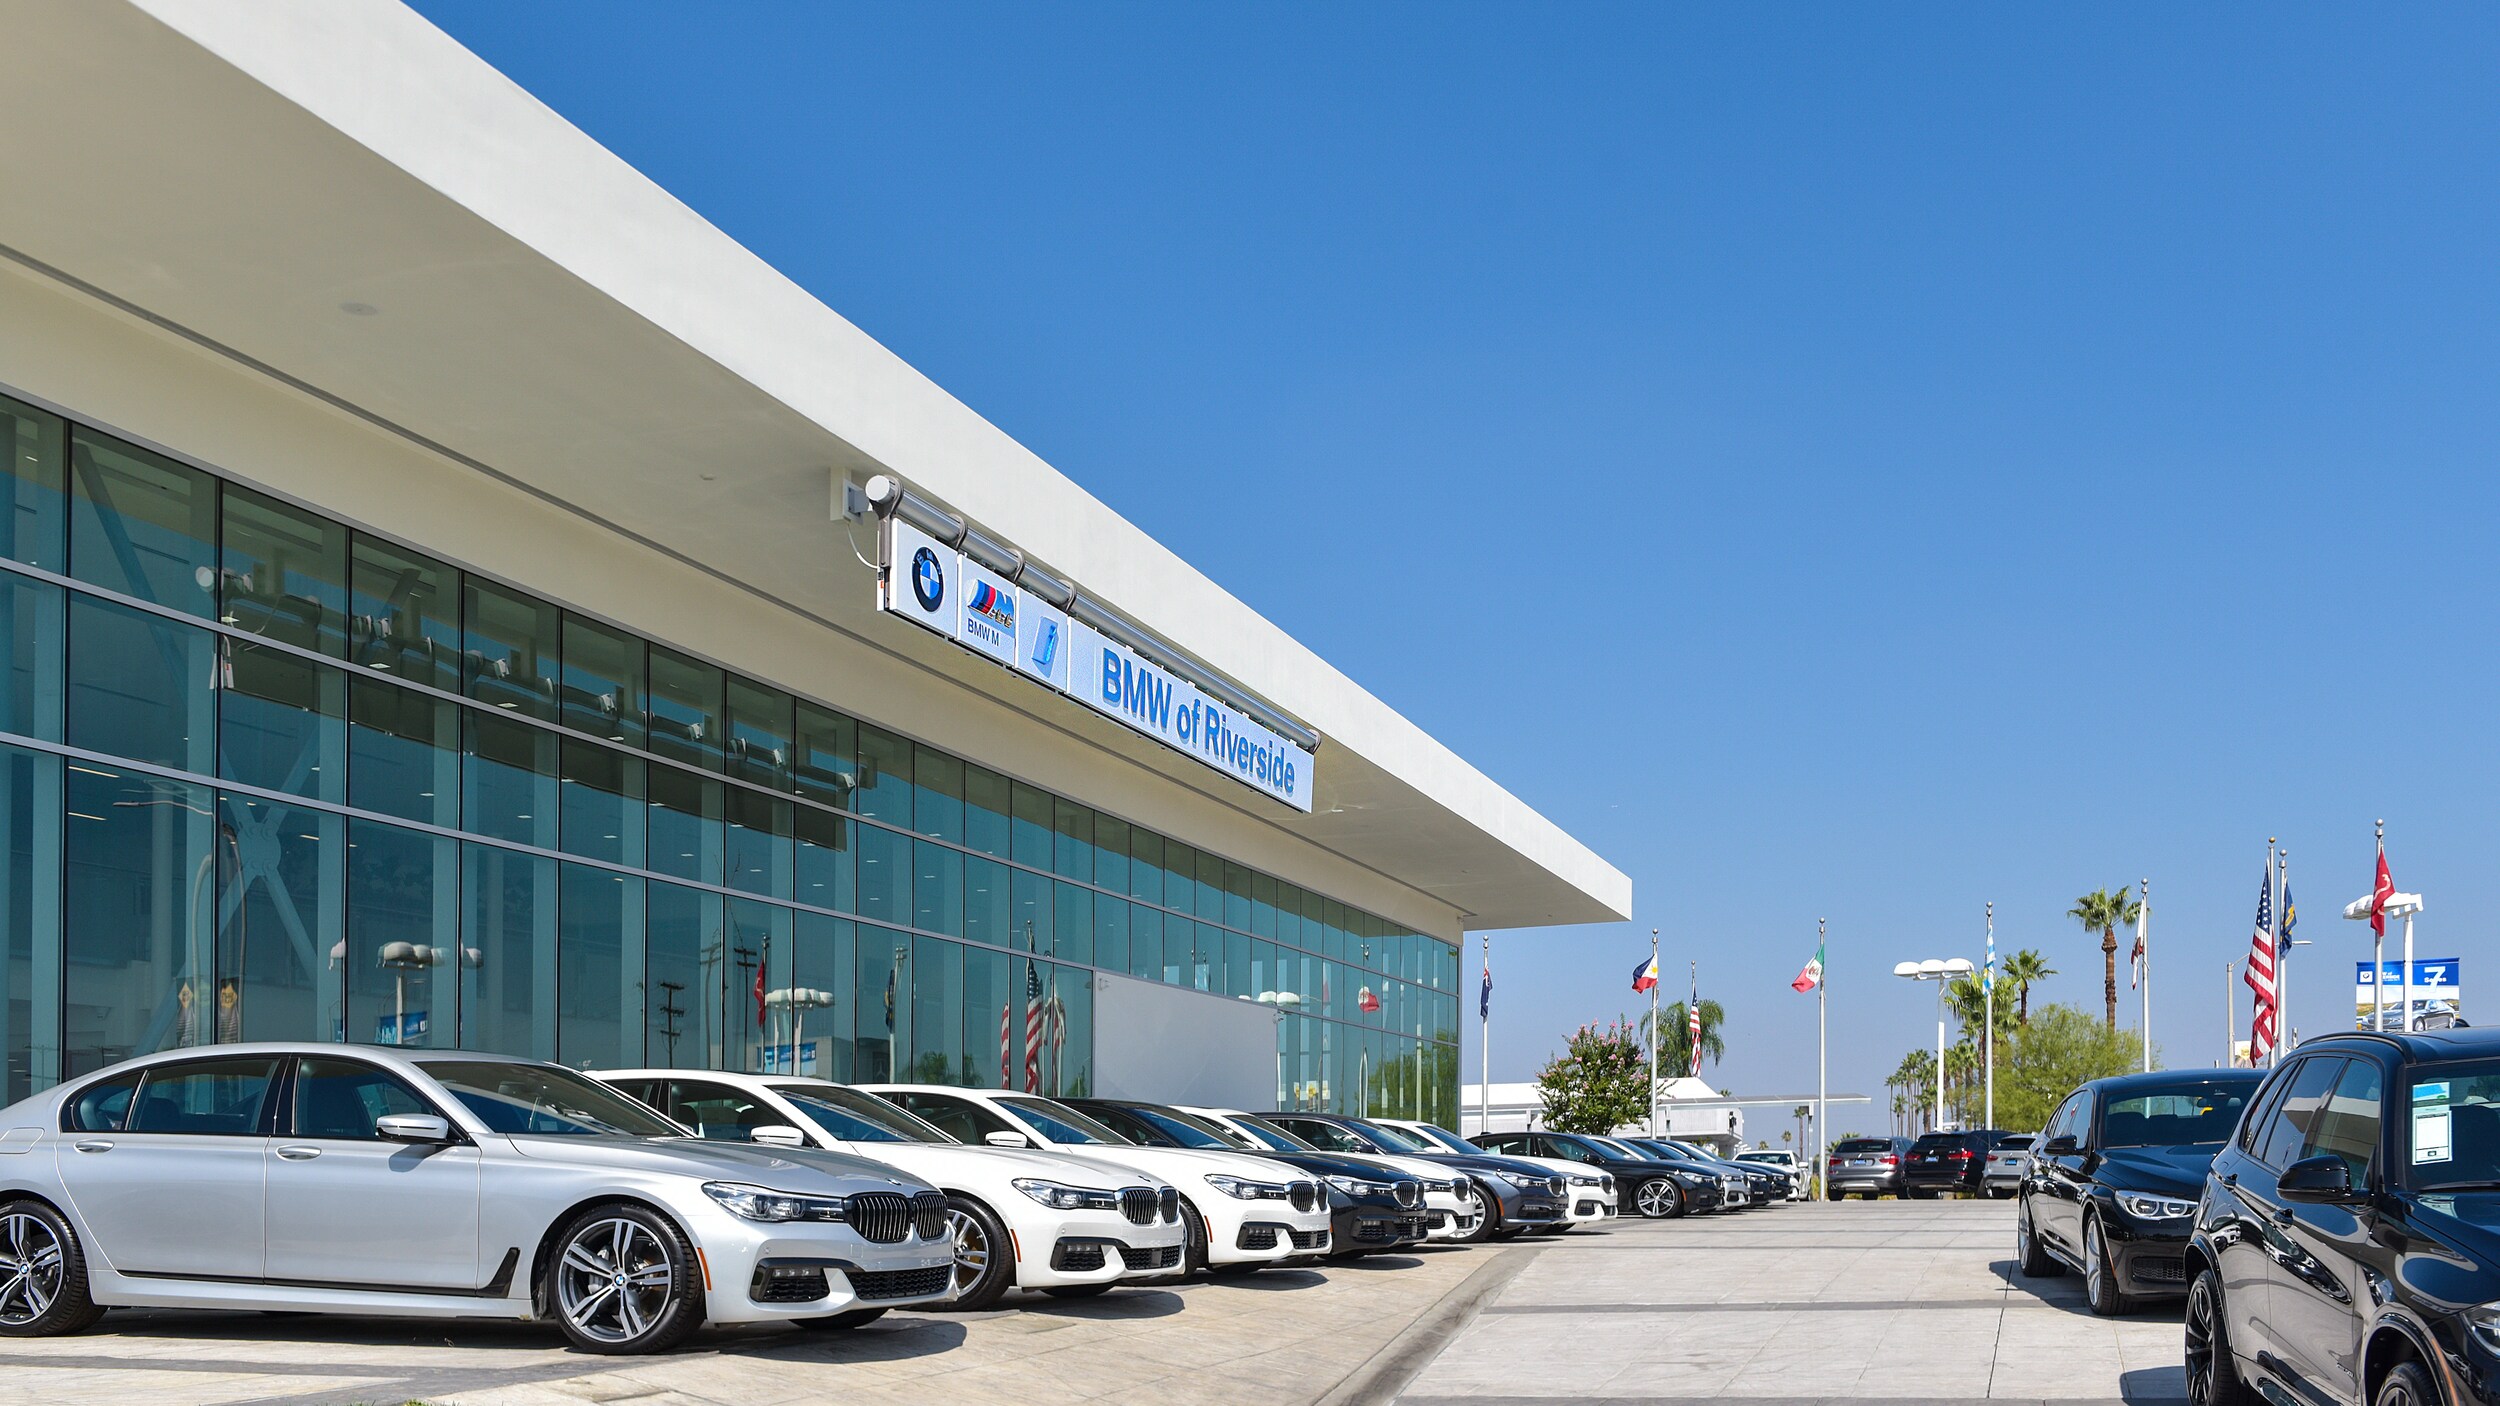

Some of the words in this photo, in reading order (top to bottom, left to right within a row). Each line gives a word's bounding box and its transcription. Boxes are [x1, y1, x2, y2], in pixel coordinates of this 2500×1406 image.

[967, 617, 990, 642] BMW
[991, 630, 1000, 647] M
[1102, 647, 1172, 732] BMW
[1176, 698, 1200, 746] of
[1205, 704, 1295, 795] Riverside
[2424, 966, 2446, 993] 7
